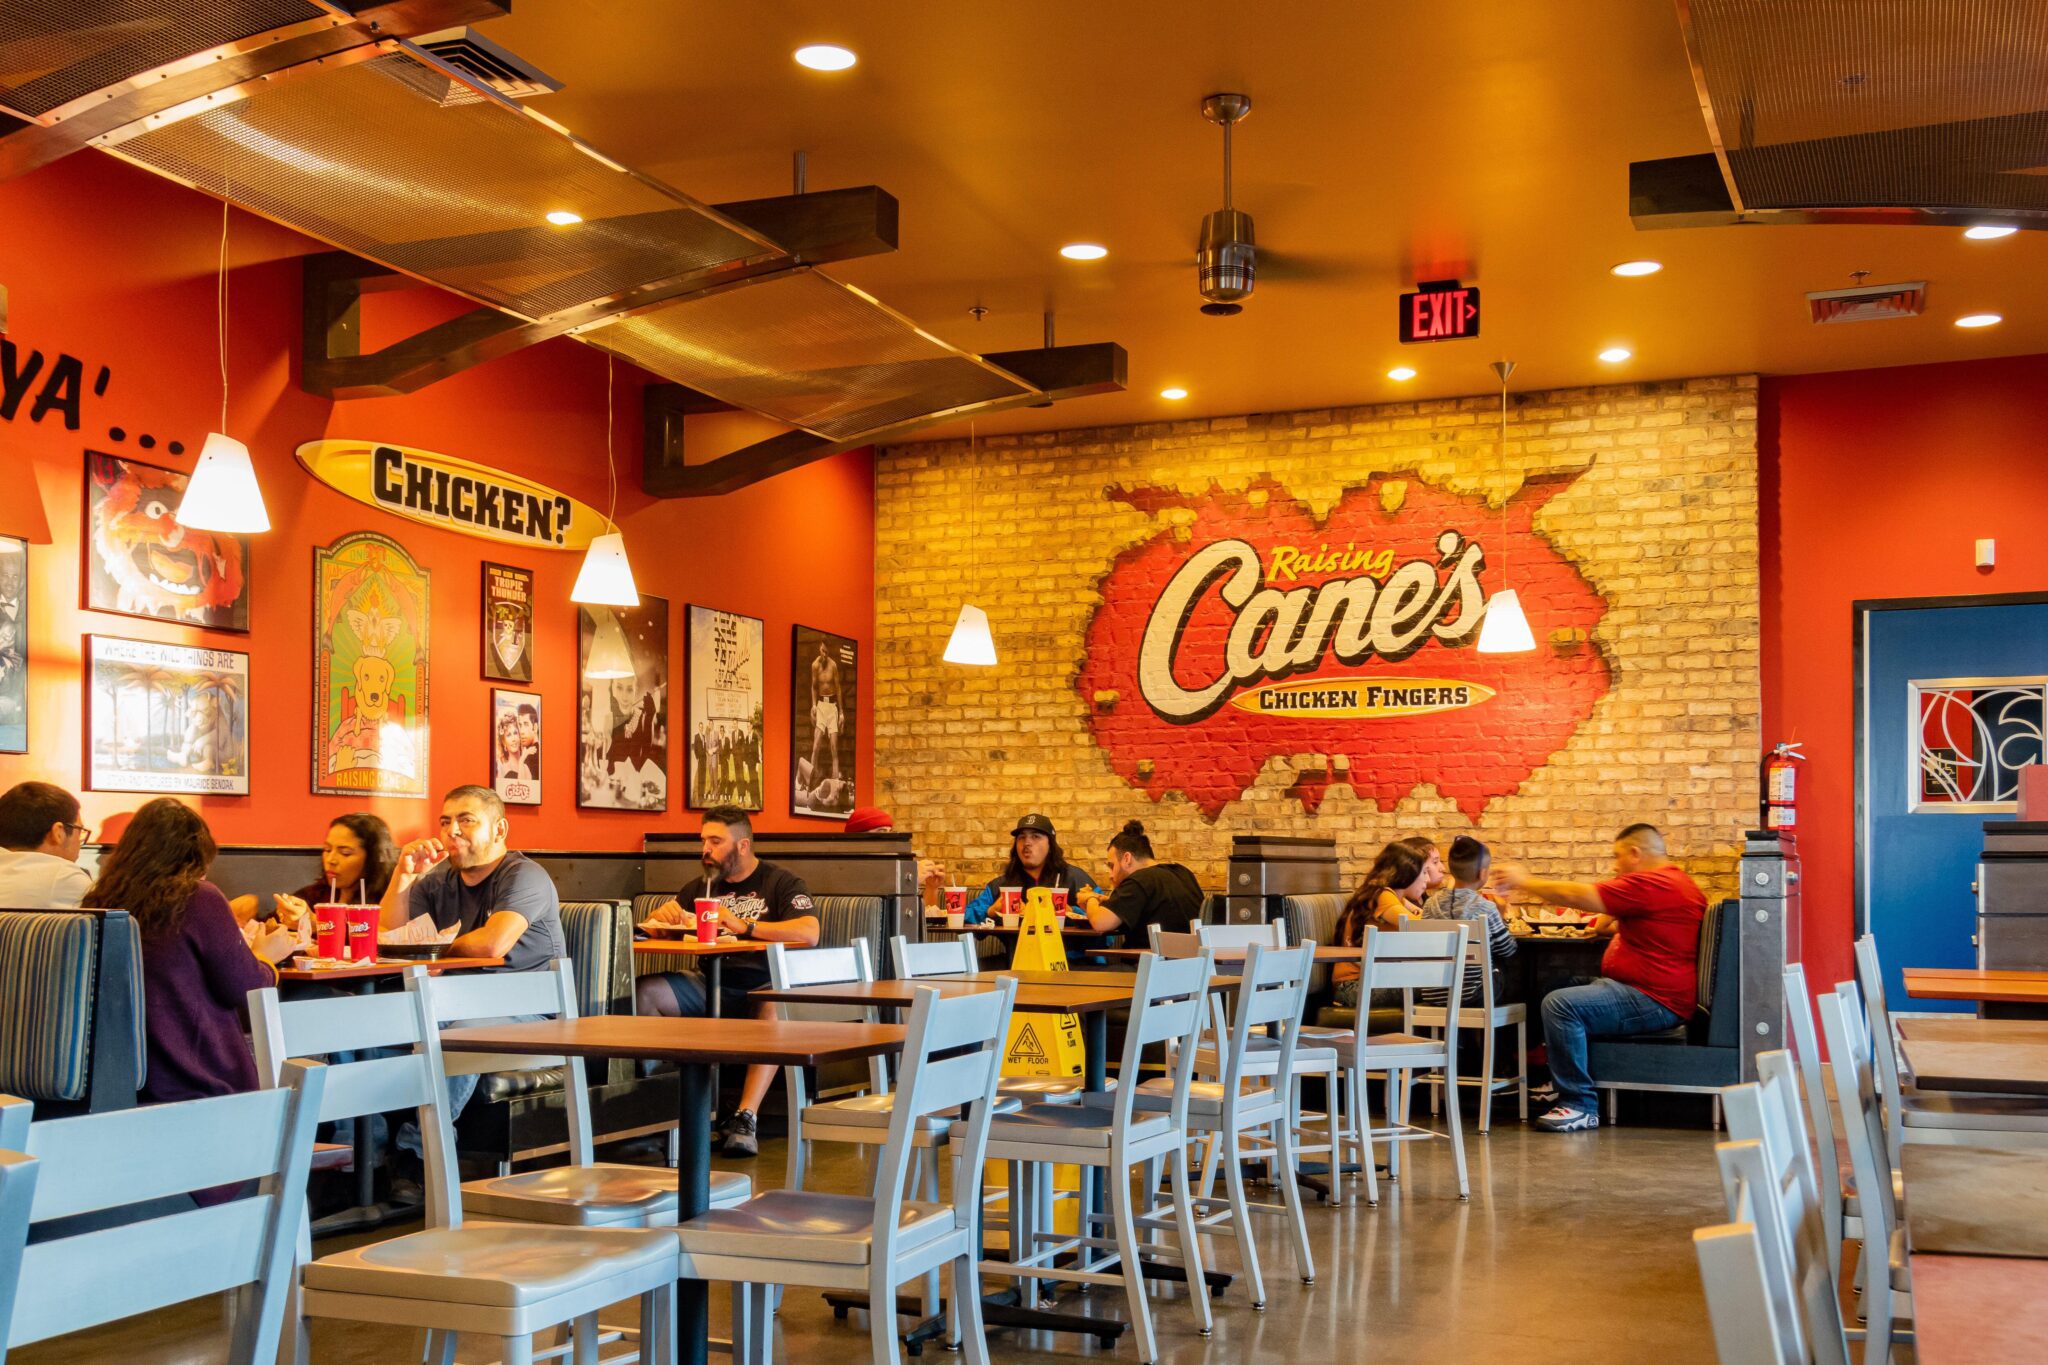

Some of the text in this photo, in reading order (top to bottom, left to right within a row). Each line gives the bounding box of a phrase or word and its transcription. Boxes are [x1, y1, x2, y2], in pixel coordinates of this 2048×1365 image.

[1413, 290, 1468, 338] EXIT
[373, 446, 572, 545] CHICKEN?
[1267, 541, 1396, 582] Raising
[491, 585, 527, 602] THUNDER
[495, 575, 524, 591] TROPIC
[1139, 529, 1486, 725] Cane's
[217, 652, 235, 669] ARE
[1258, 684, 1469, 711] CHICKEN FINGERS
[336, 770, 376, 787] RAISING
[1007, 1056, 1049, 1065] WET FLOOR
